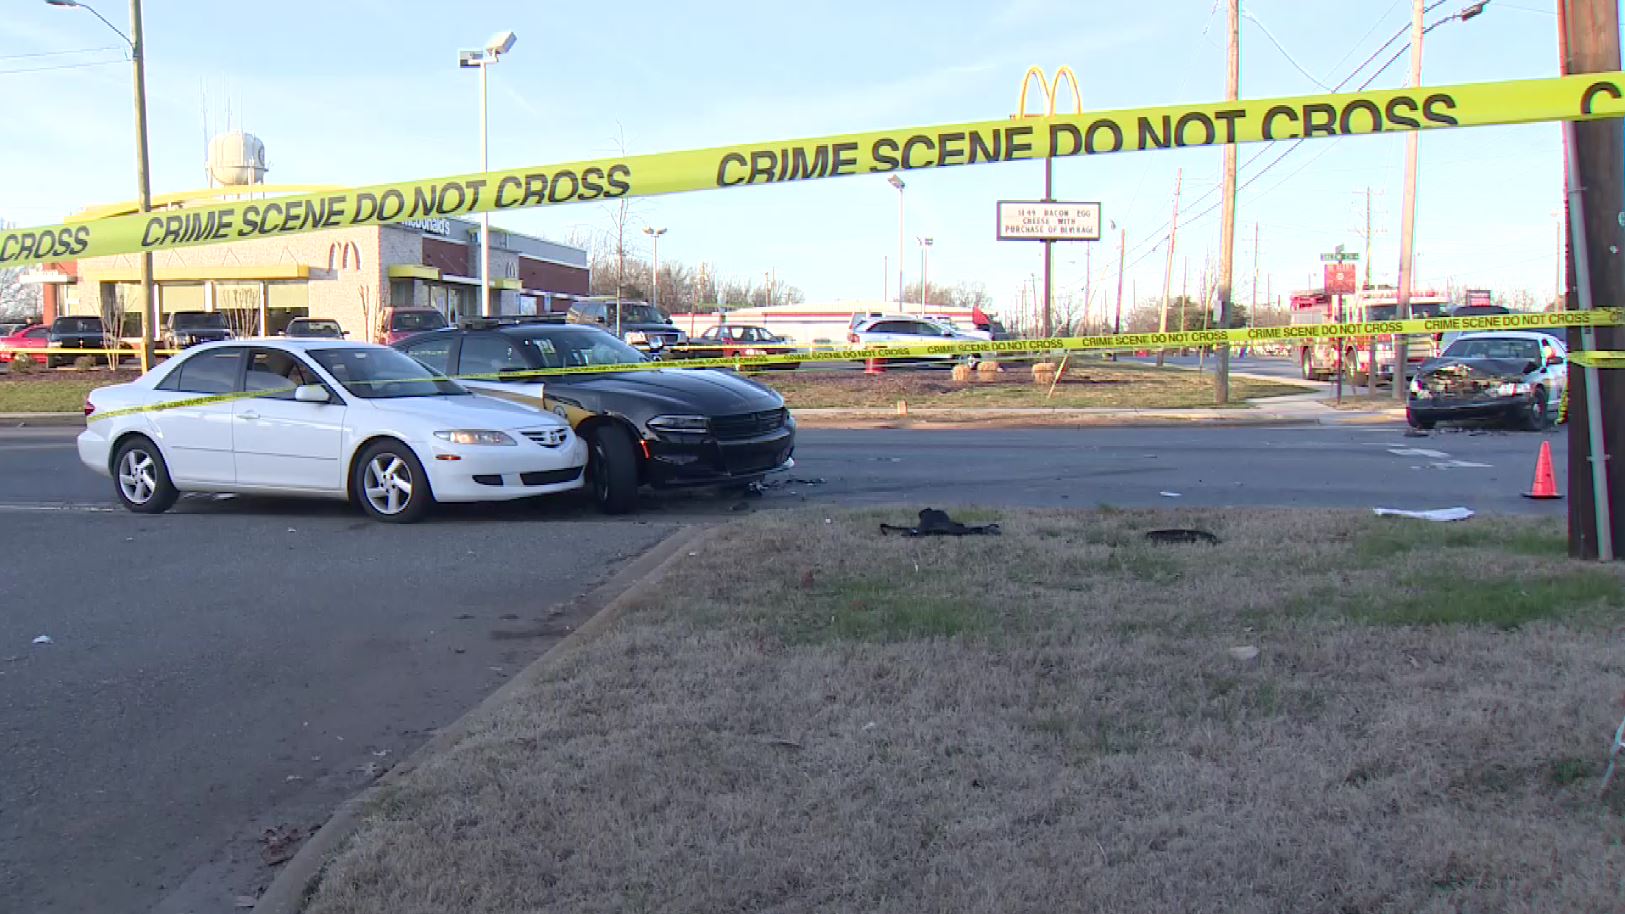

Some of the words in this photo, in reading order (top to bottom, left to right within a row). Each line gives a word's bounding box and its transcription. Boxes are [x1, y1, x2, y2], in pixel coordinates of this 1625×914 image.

[716, 142, 859, 187] CRIME
[870, 126, 1034, 173] SCENE
[1050, 118, 1123, 157] DO
[1138, 109, 1247, 150] NOT
[1262, 94, 1459, 140] CROSS
[141, 208, 235, 247] CRIME
[238, 195, 347, 237] SCENE
[350, 189, 405, 224] DO
[408, 180, 487, 218] NOT
[495, 164, 631, 209] CROSS
[1005, 225, 1044, 233] PURCHASE
[1060, 226, 1093, 234] BEVERAGE
[0, 225, 90, 262] CROSS
[1425, 318, 1460, 330] CRIME
[1462, 316, 1500, 328] SCENE
[1502, 315, 1521, 326] DO
[1522, 314, 1546, 325] NOT
[1549, 313, 1590, 324] CROSS
[1248, 328, 1281, 338] CRIME
[1283, 326, 1319, 337] SCENE
[1321, 325, 1338, 335] DO
[1340, 323, 1361, 334] NOT
[1364, 322, 1403, 333] CROSS
[928, 345, 956, 354] CRIME
[958, 343, 990, 352] SCENE
[991, 341, 1006, 351] DO
[1008, 340, 1028, 350] NOT
[1029, 339, 1064, 349] CROSS
[1082, 337, 1113, 347] CRIME
[1115, 335, 1150, 345] SCENE
[1152, 333, 1167, 343] DO
[1168, 332, 1189, 342] NOT
[1192, 331, 1228, 341] CROSS
